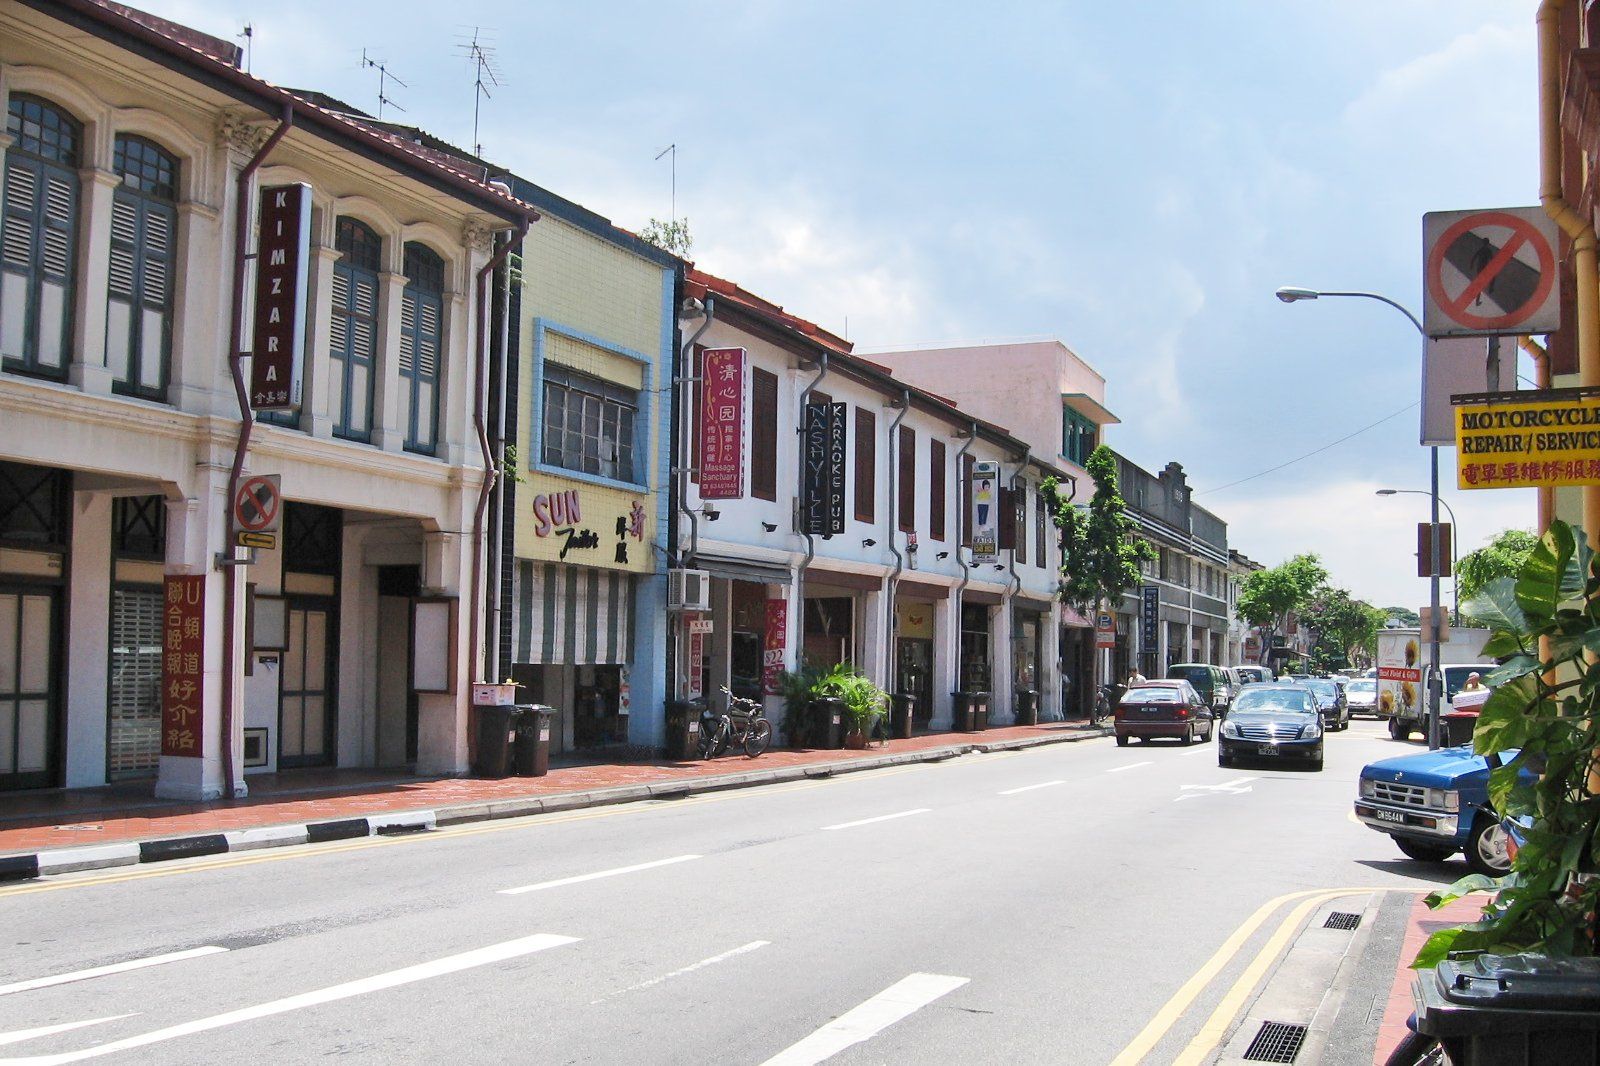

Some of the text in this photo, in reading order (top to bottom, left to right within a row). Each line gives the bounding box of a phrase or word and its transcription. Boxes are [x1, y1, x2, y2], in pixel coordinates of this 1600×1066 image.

[266, 192, 287, 381] KIMZARA
[1462, 407, 1600, 430] MOTORCYCLE
[1536, 430, 1600, 451] SERVIC
[702, 472, 738, 482] Sanctuary
[704, 463, 736, 473] Massage
[831, 405, 842, 531] KARAOKE PUB
[533, 489, 581, 538] SUN
